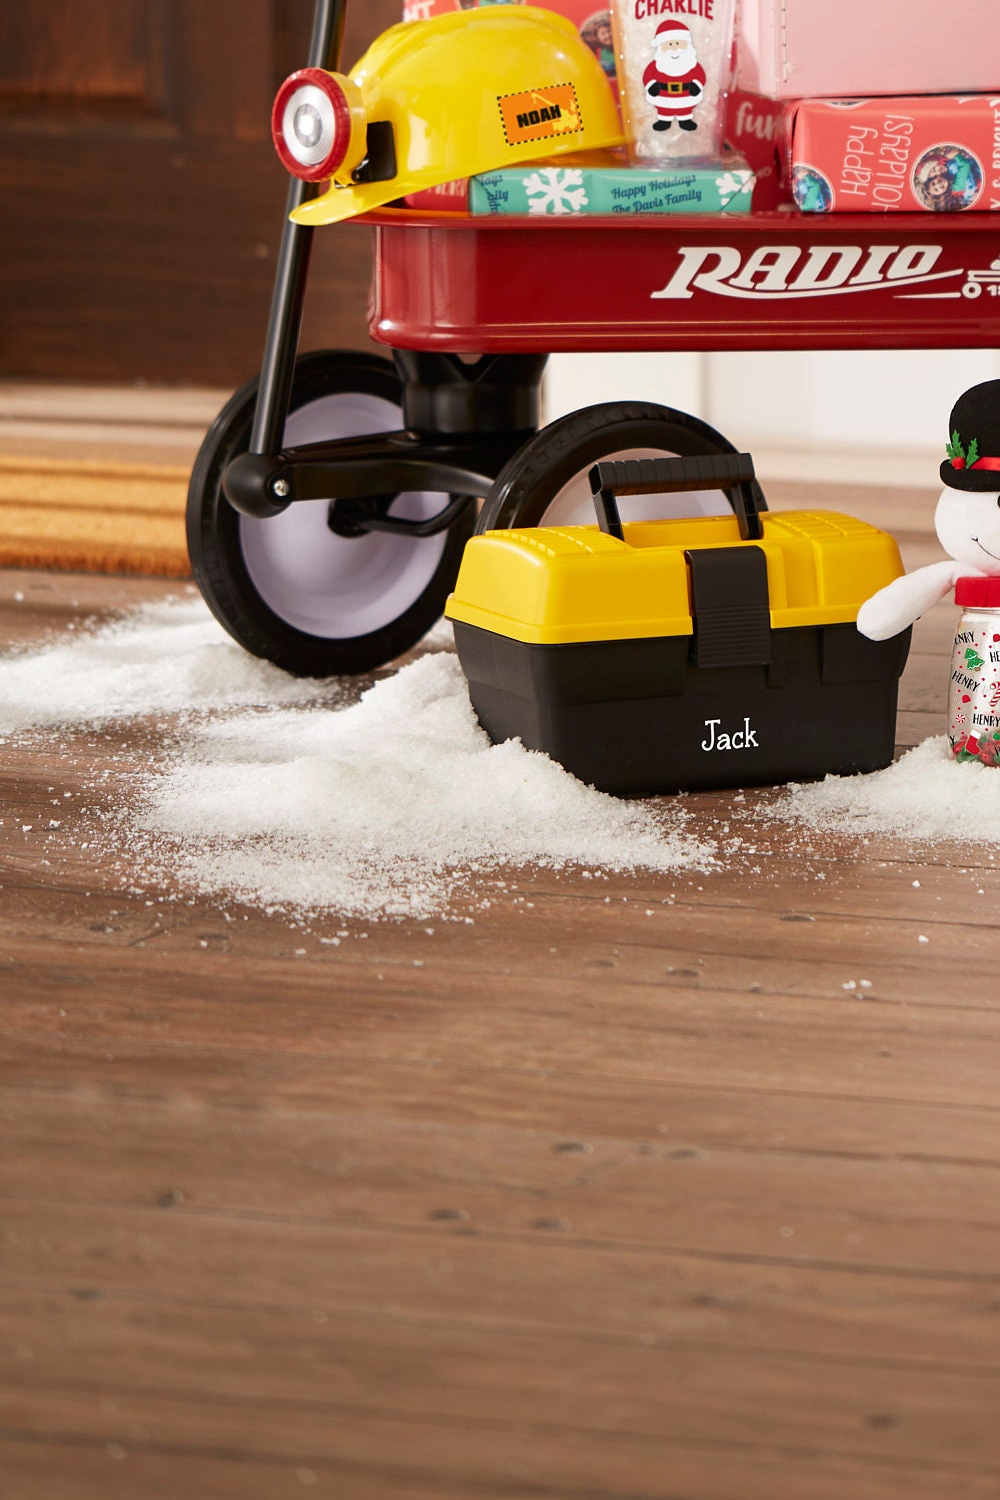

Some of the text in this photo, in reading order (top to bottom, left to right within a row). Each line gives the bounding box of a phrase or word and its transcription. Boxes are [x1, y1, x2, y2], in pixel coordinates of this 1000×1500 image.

[516, 104, 562, 128] NOAH
[611, 174, 697, 200] Happy Holidays
[633, 197, 664, 212] Davis
[664, 189, 702, 205] Family
[650, 245, 944, 298] RADIO
[952, 670, 980, 692] HENRY
[972, 712, 1000, 727] HENRY
[701, 717, 760, 752] Jack
